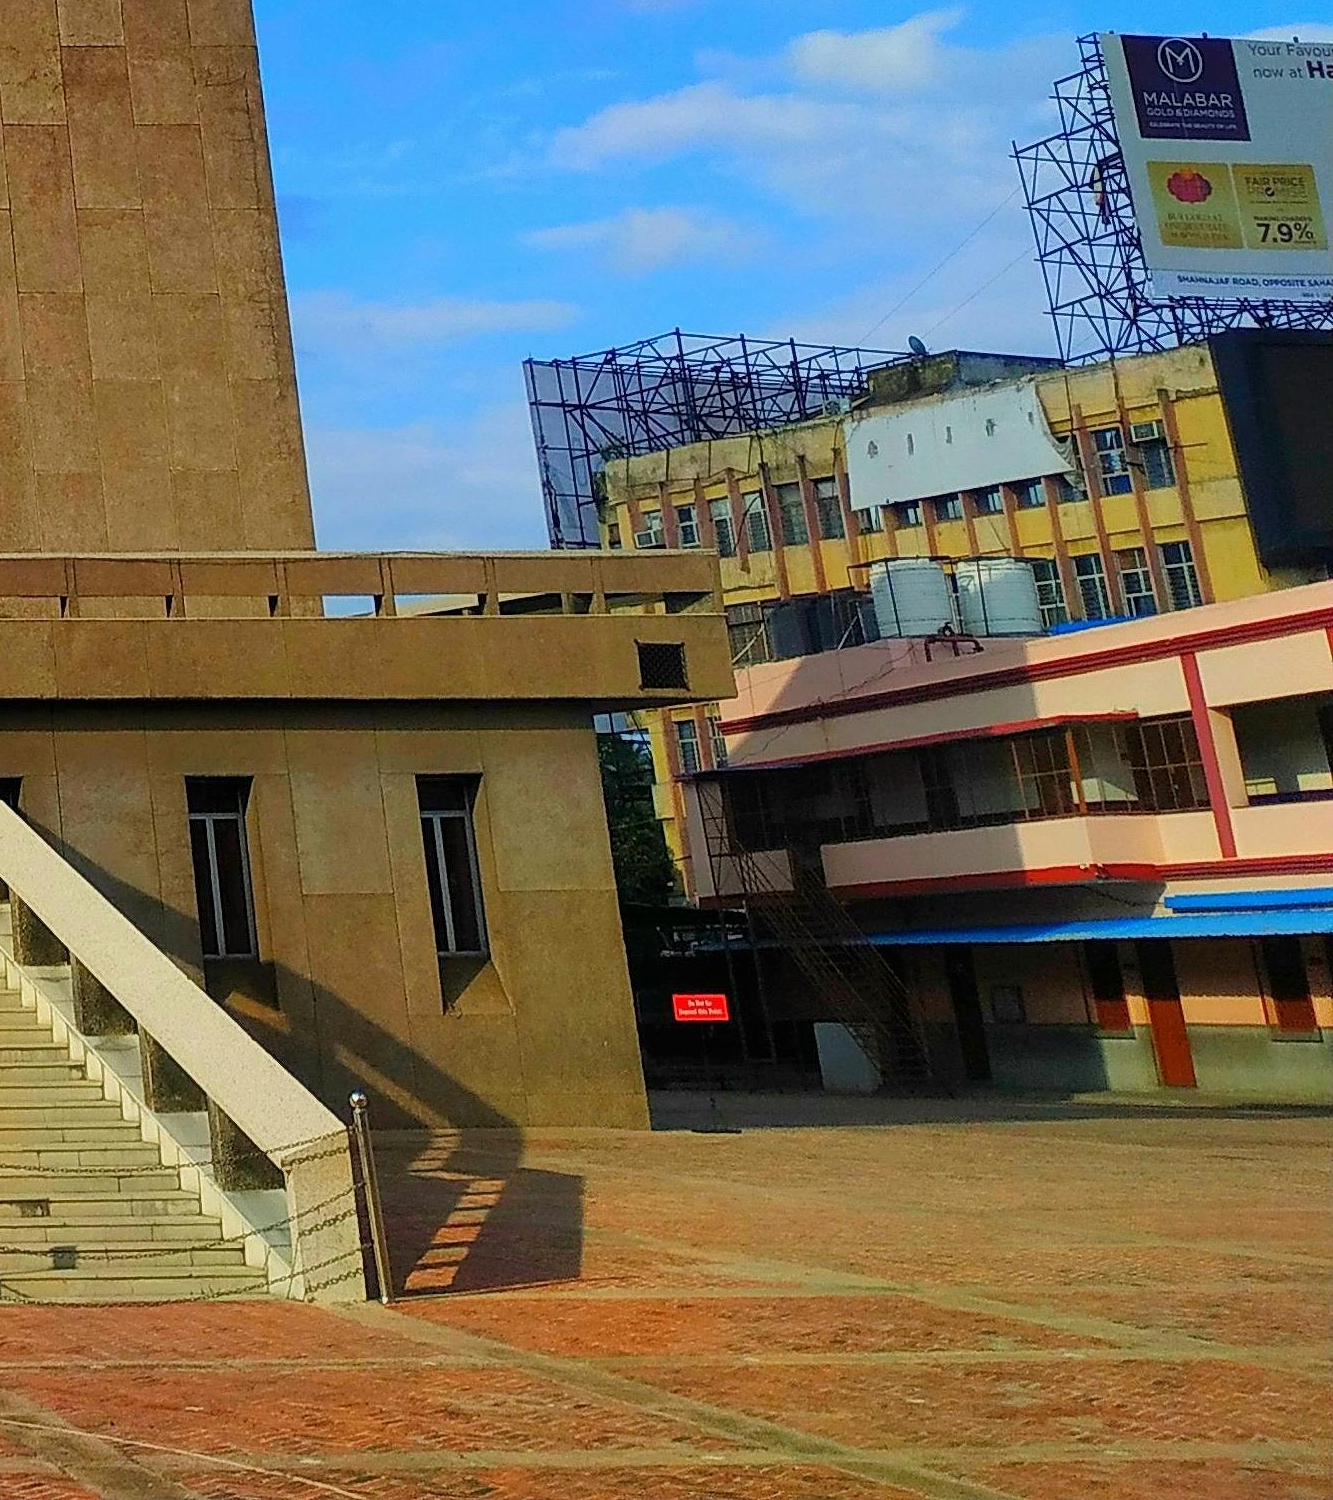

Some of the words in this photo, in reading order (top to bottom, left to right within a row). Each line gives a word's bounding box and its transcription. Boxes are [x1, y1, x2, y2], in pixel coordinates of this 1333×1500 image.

[1248, 44, 1282, 56] Your
[1288, 45, 1333, 58] Favou
[1254, 68, 1284, 79] now
[1289, 66, 1303, 79] at
[1143, 91, 1234, 108] MALABAR
[1146, 107, 1175, 117] GOLD
[1183, 108, 1236, 118] DIAMONDS
[1245, 177, 1270, 186] FAIR
[1272, 177, 1305, 187] PRICE
[1256, 222, 1314, 244] 7.9%
[1233, 276, 1262, 287] ROAD,
[1263, 276, 1307, 287] OPPOSITE
